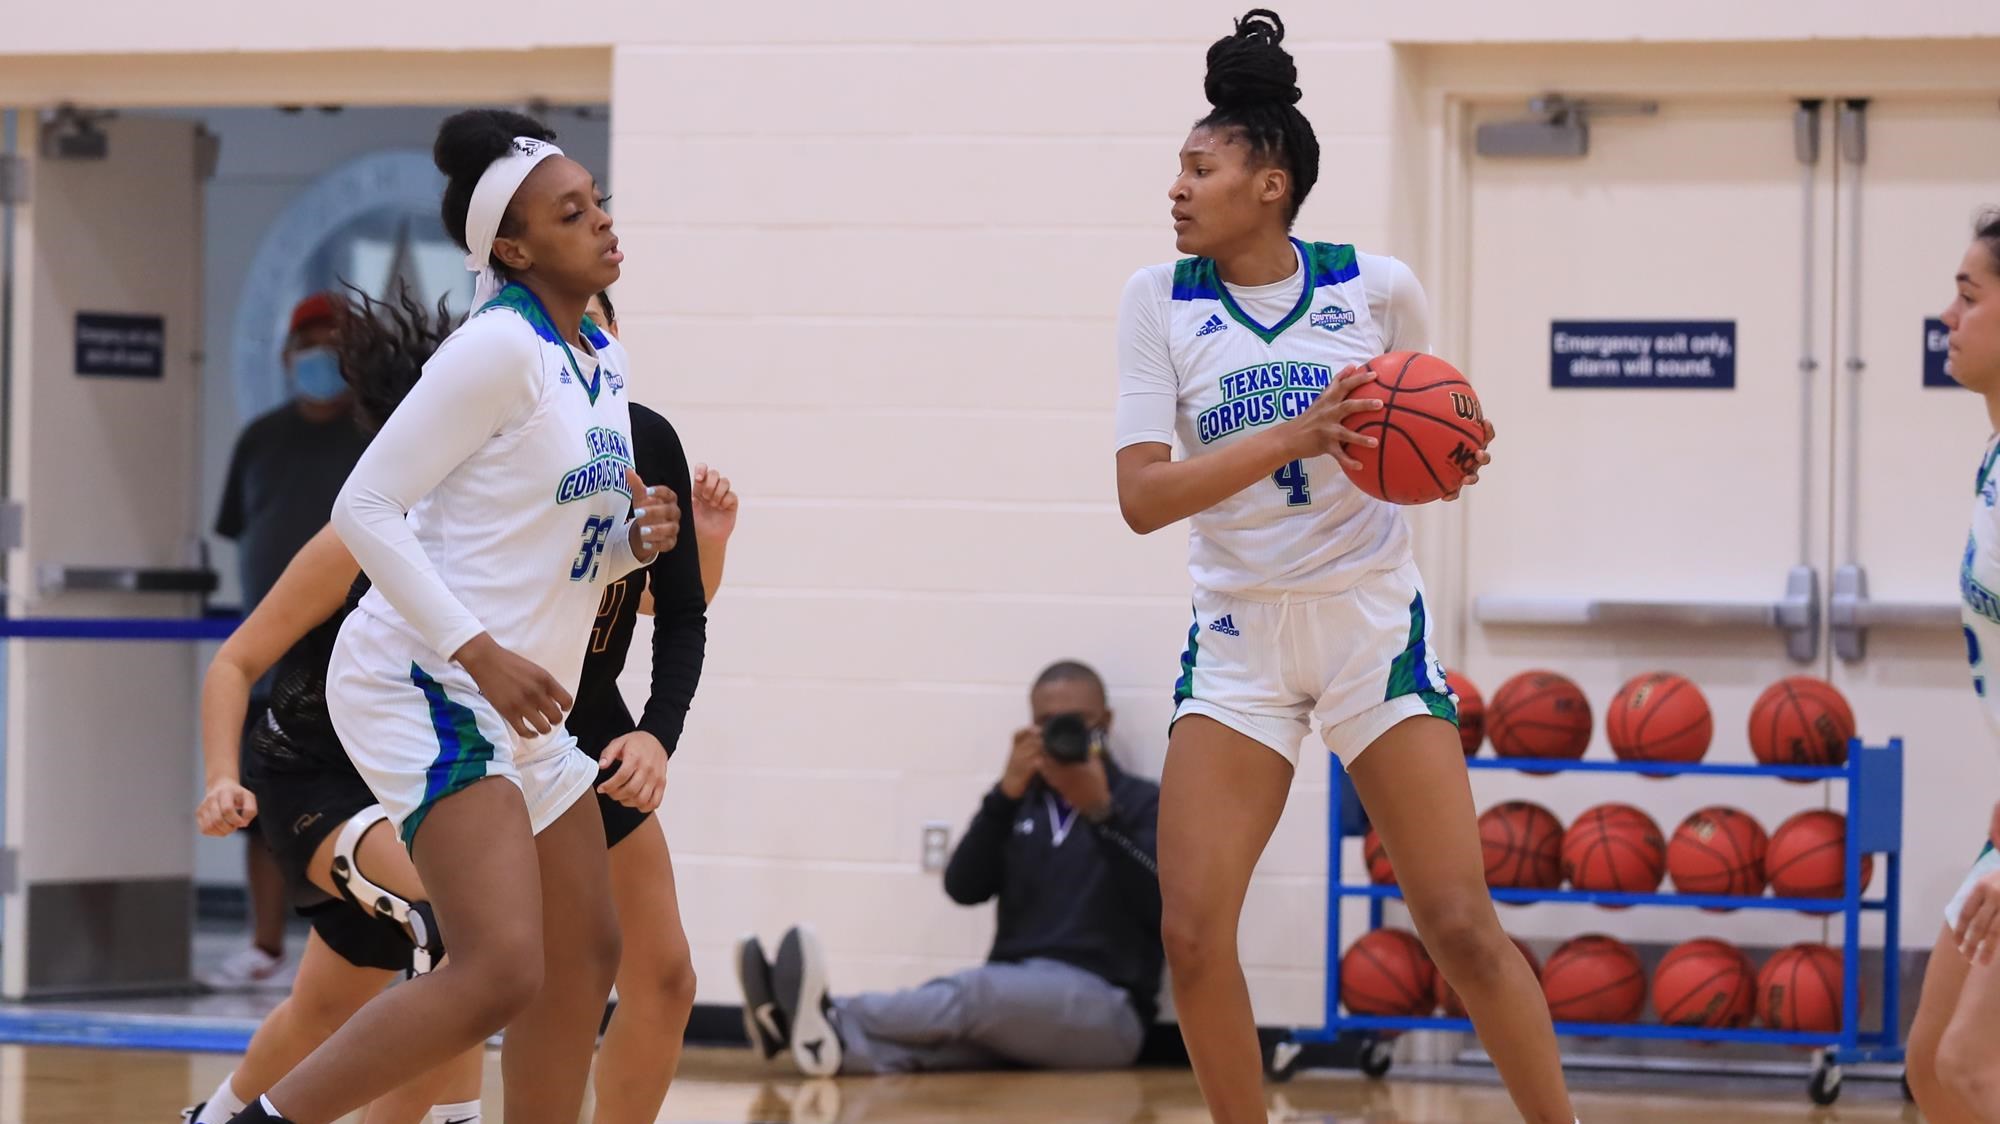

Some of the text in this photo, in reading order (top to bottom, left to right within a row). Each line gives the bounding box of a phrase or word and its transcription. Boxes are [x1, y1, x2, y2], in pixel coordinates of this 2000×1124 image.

[1195, 324, 1228, 337] adidas
[1311, 311, 1354, 325] SOUTHLAND
[1553, 332, 1651, 358] Emergency
[1654, 332, 1688, 353] exit
[1569, 356, 1621, 377] alarm
[1622, 355, 1653, 377] will
[1222, 363, 1330, 400] TEXAS A&M
[1199, 393, 1276, 442] CORPUS
[559, 459, 612, 501] CORPUS
[1271, 458, 1311, 507] 4
[1208, 623, 1240, 637] adidas
